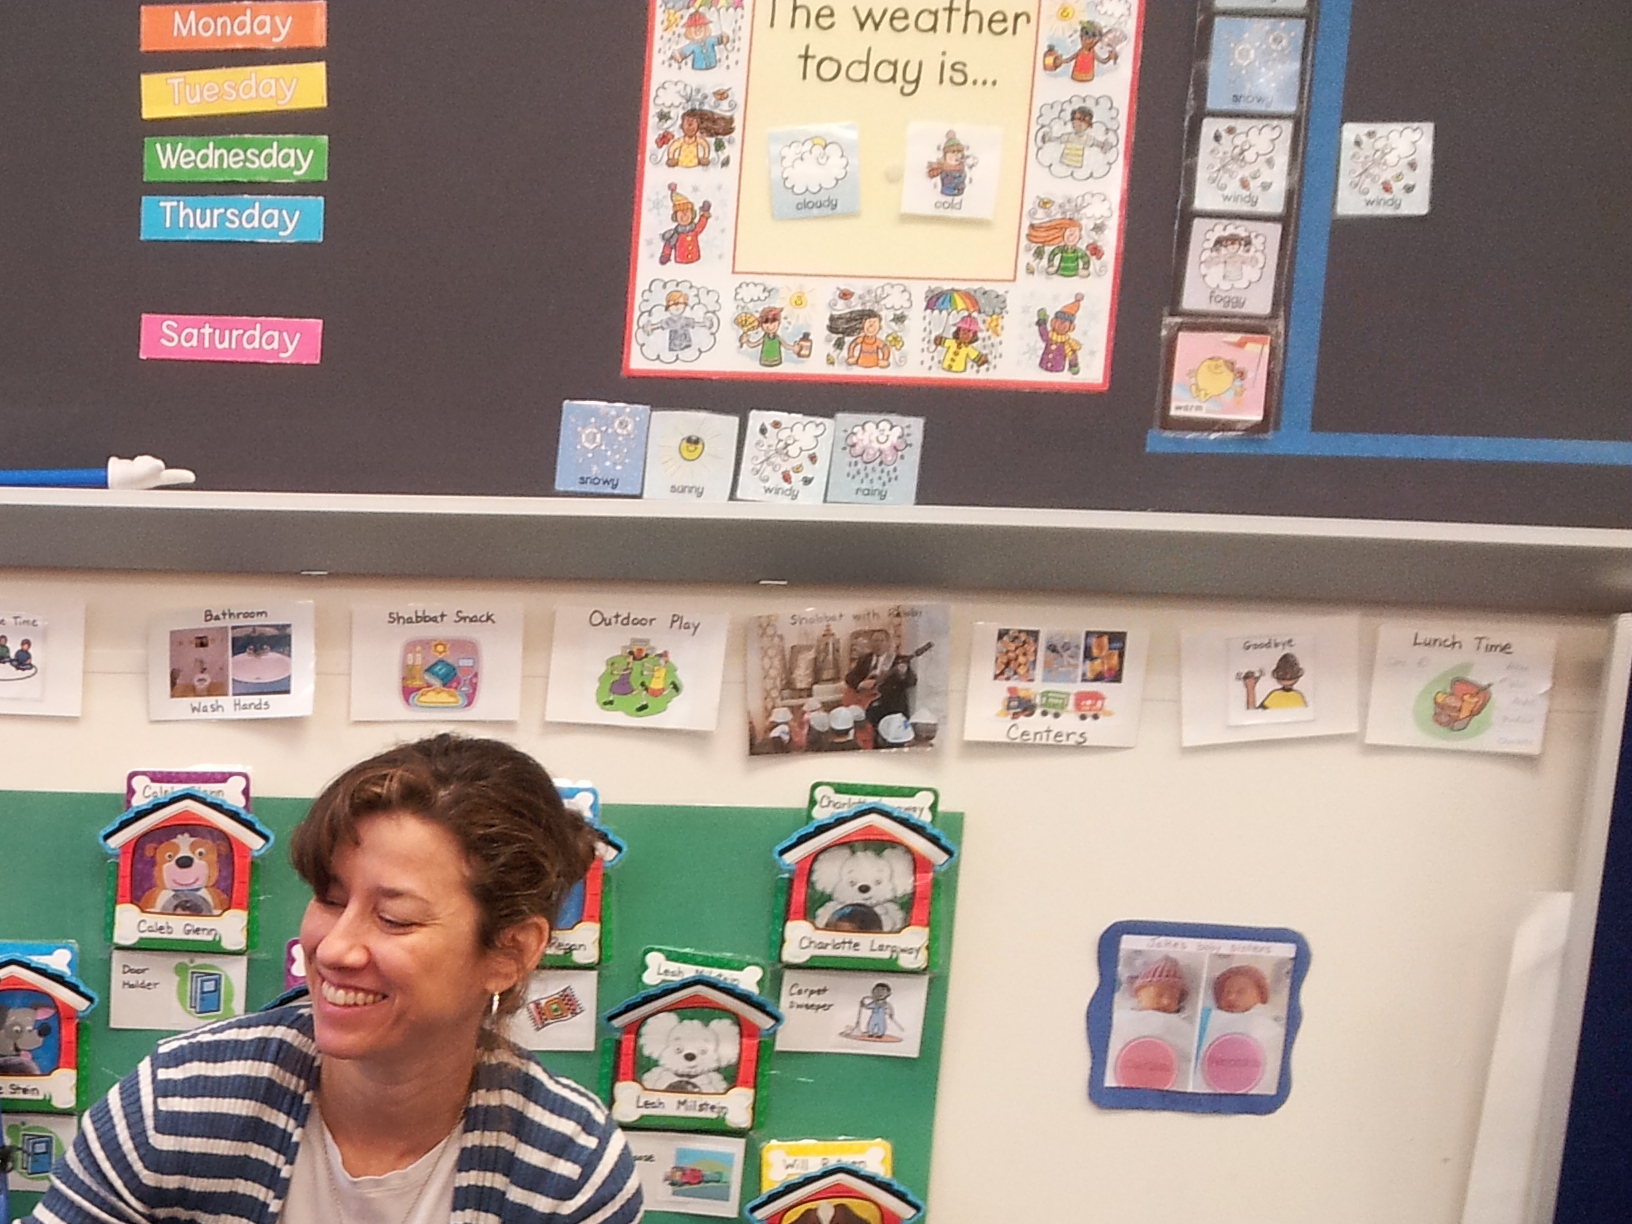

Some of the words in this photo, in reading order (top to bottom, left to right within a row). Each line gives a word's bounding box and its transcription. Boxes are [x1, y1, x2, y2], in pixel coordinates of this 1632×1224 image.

[172, 9, 293, 43] Monday
[769, 0, 836, 31] The
[852, 0, 1031, 36] weather
[797, 43, 923, 97] today
[938, 50, 998, 87] is...
[166, 72, 299, 106] Tuesday
[155, 141, 314, 176] Wednesday
[795, 197, 838, 211] cloudy
[934, 198, 962, 211] cold
[1221, 190, 1259, 208] windy
[1363, 194, 1403, 211] windy
[158, 200, 302, 236] Thursday
[1208, 291, 1247, 309] foggy
[159, 319, 302, 358] Saturday
[578, 475, 619, 489] snowy
[670, 484, 705, 498] sunny
[763, 483, 799, 501] windy
[855, 485, 888, 501] rainy
[12, 615, 39, 627] Time
[203, 607, 269, 623] Bathroom
[386, 609, 448, 627] Shabbat
[454, 609, 497, 625] Snack
[589, 609, 657, 629] Outdoor
[669, 612, 702, 637] Play
[1242, 636, 1296, 651] Goodbye
[1413, 632, 1463, 650] Lunch
[1473, 636, 1514, 655] Time
[190, 700, 225, 715] Wash
[233, 698, 271, 713] Hands
[1006, 723, 1088, 745] Centers
[137, 920, 173, 934] Caleb
[183, 923, 218, 937] Glenn
[798, 936, 861, 951] Charlotte
[122, 964, 149, 975] Door
[657, 963, 684, 977] Leah
[122, 979, 160, 990] Holder
[9, 1083, 40, 1096] Stein
[636, 1095, 665, 1109] Leah
[782, 1158, 808, 1171] Will
